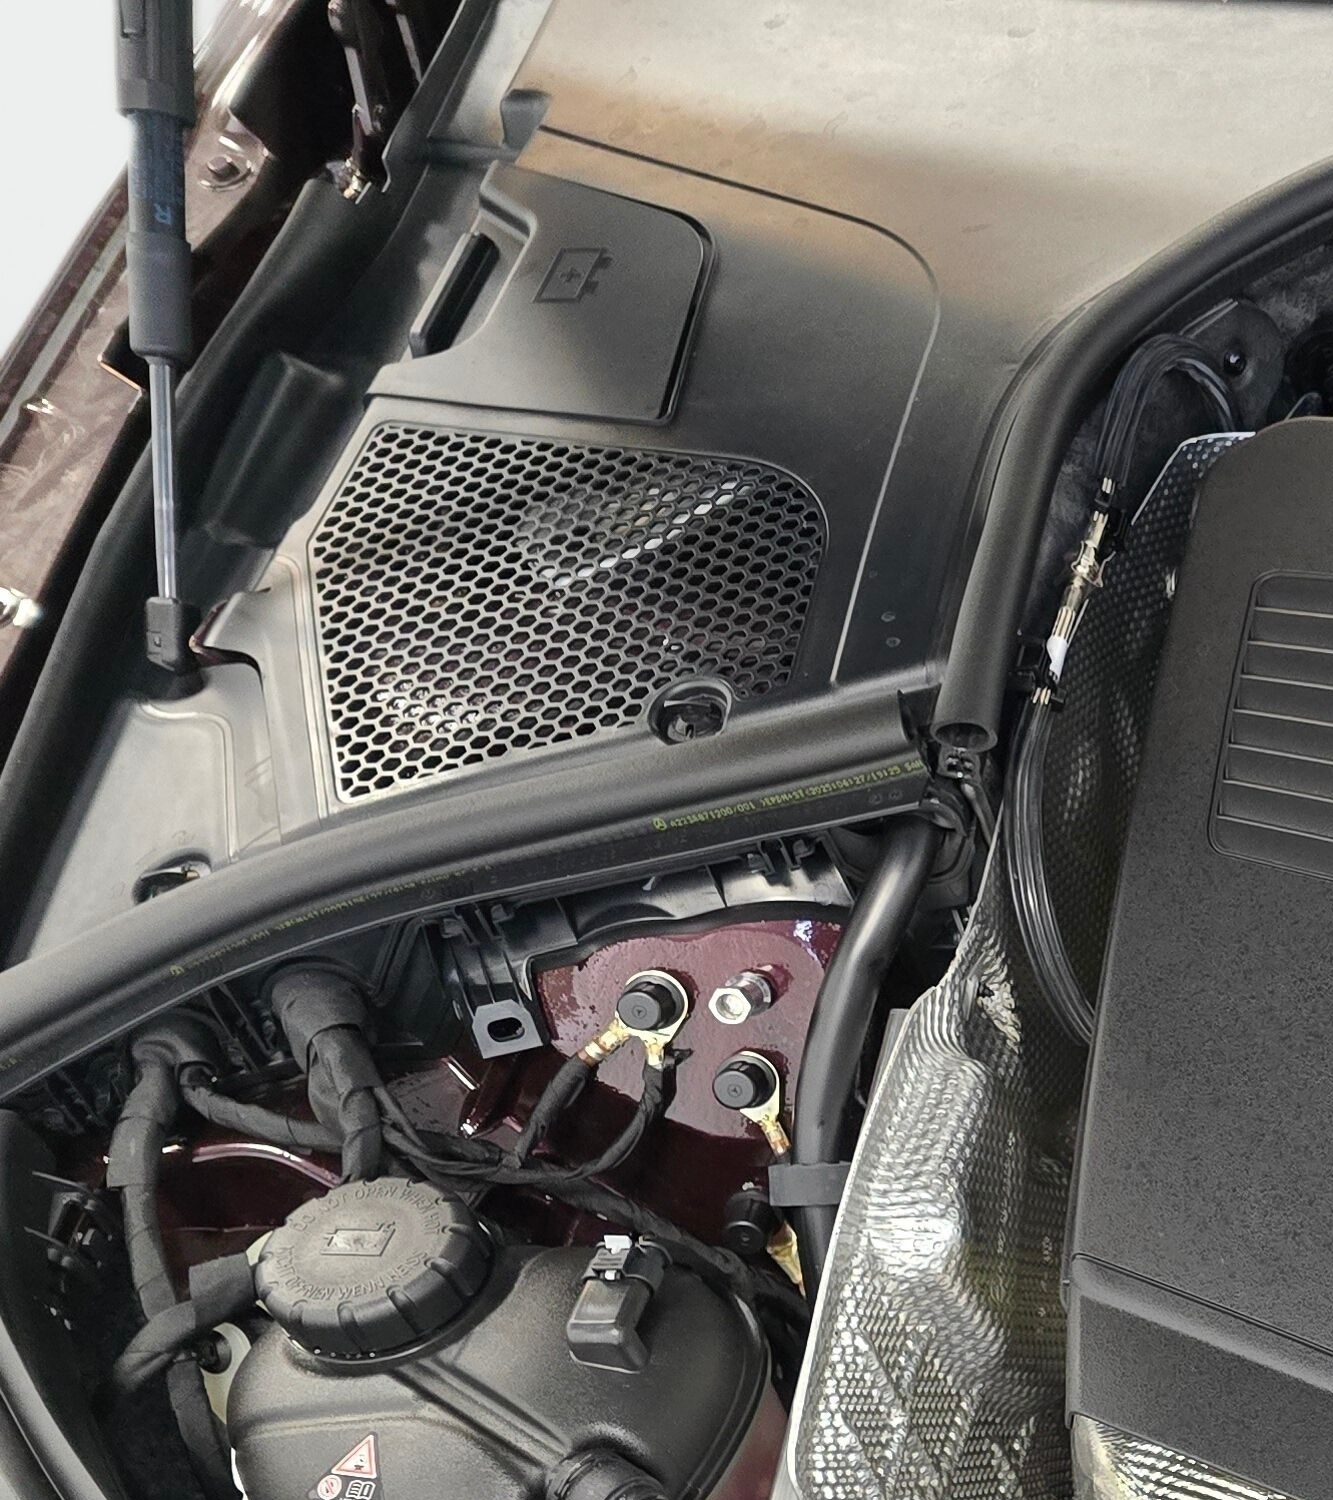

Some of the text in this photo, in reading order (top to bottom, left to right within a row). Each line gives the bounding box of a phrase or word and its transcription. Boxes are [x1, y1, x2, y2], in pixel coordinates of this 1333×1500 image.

[355, 1185, 398, 1201] OPEN
[400, 1187, 436, 1214] WHEN
[338, 1276, 386, 1301] WENN
